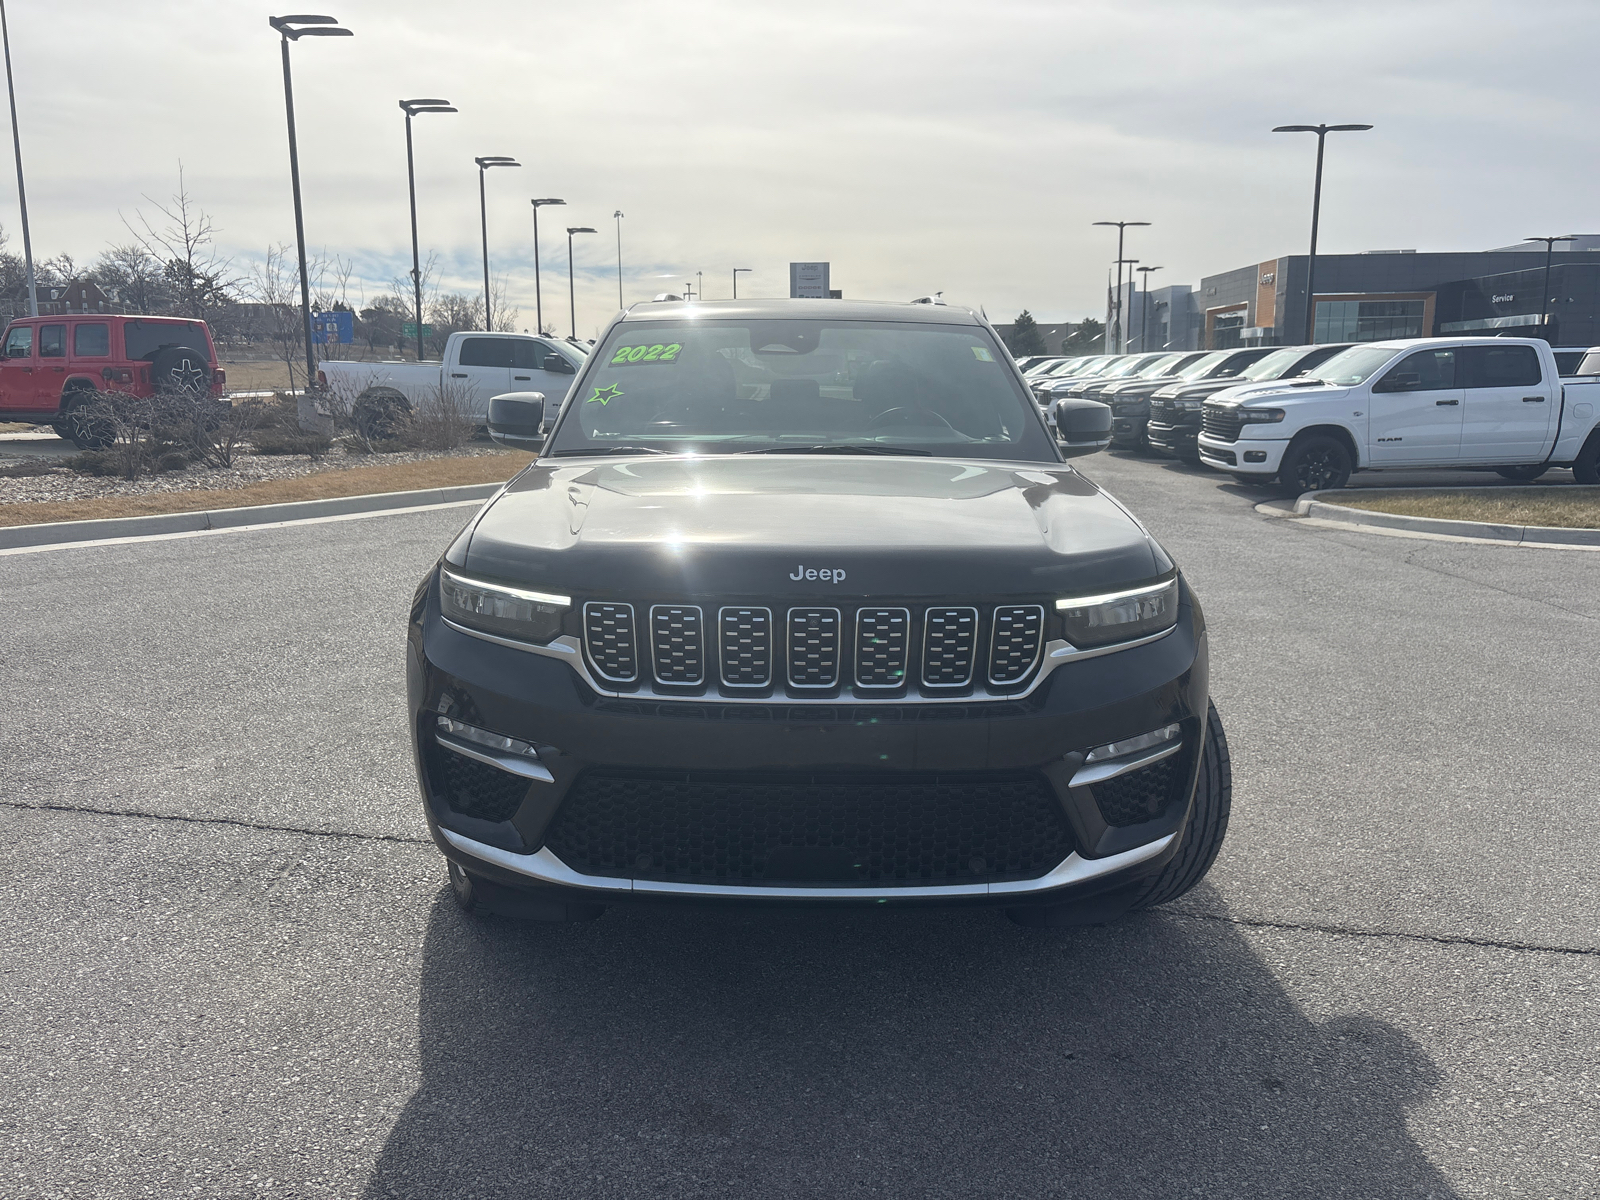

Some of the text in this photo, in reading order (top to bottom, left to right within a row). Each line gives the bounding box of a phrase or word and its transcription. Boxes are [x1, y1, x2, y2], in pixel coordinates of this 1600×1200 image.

[801, 264, 819, 272] Jeep
[1491, 293, 1514, 303] Service
[610, 343, 683, 364] 2022
[789, 564, 847, 584] Jeep
